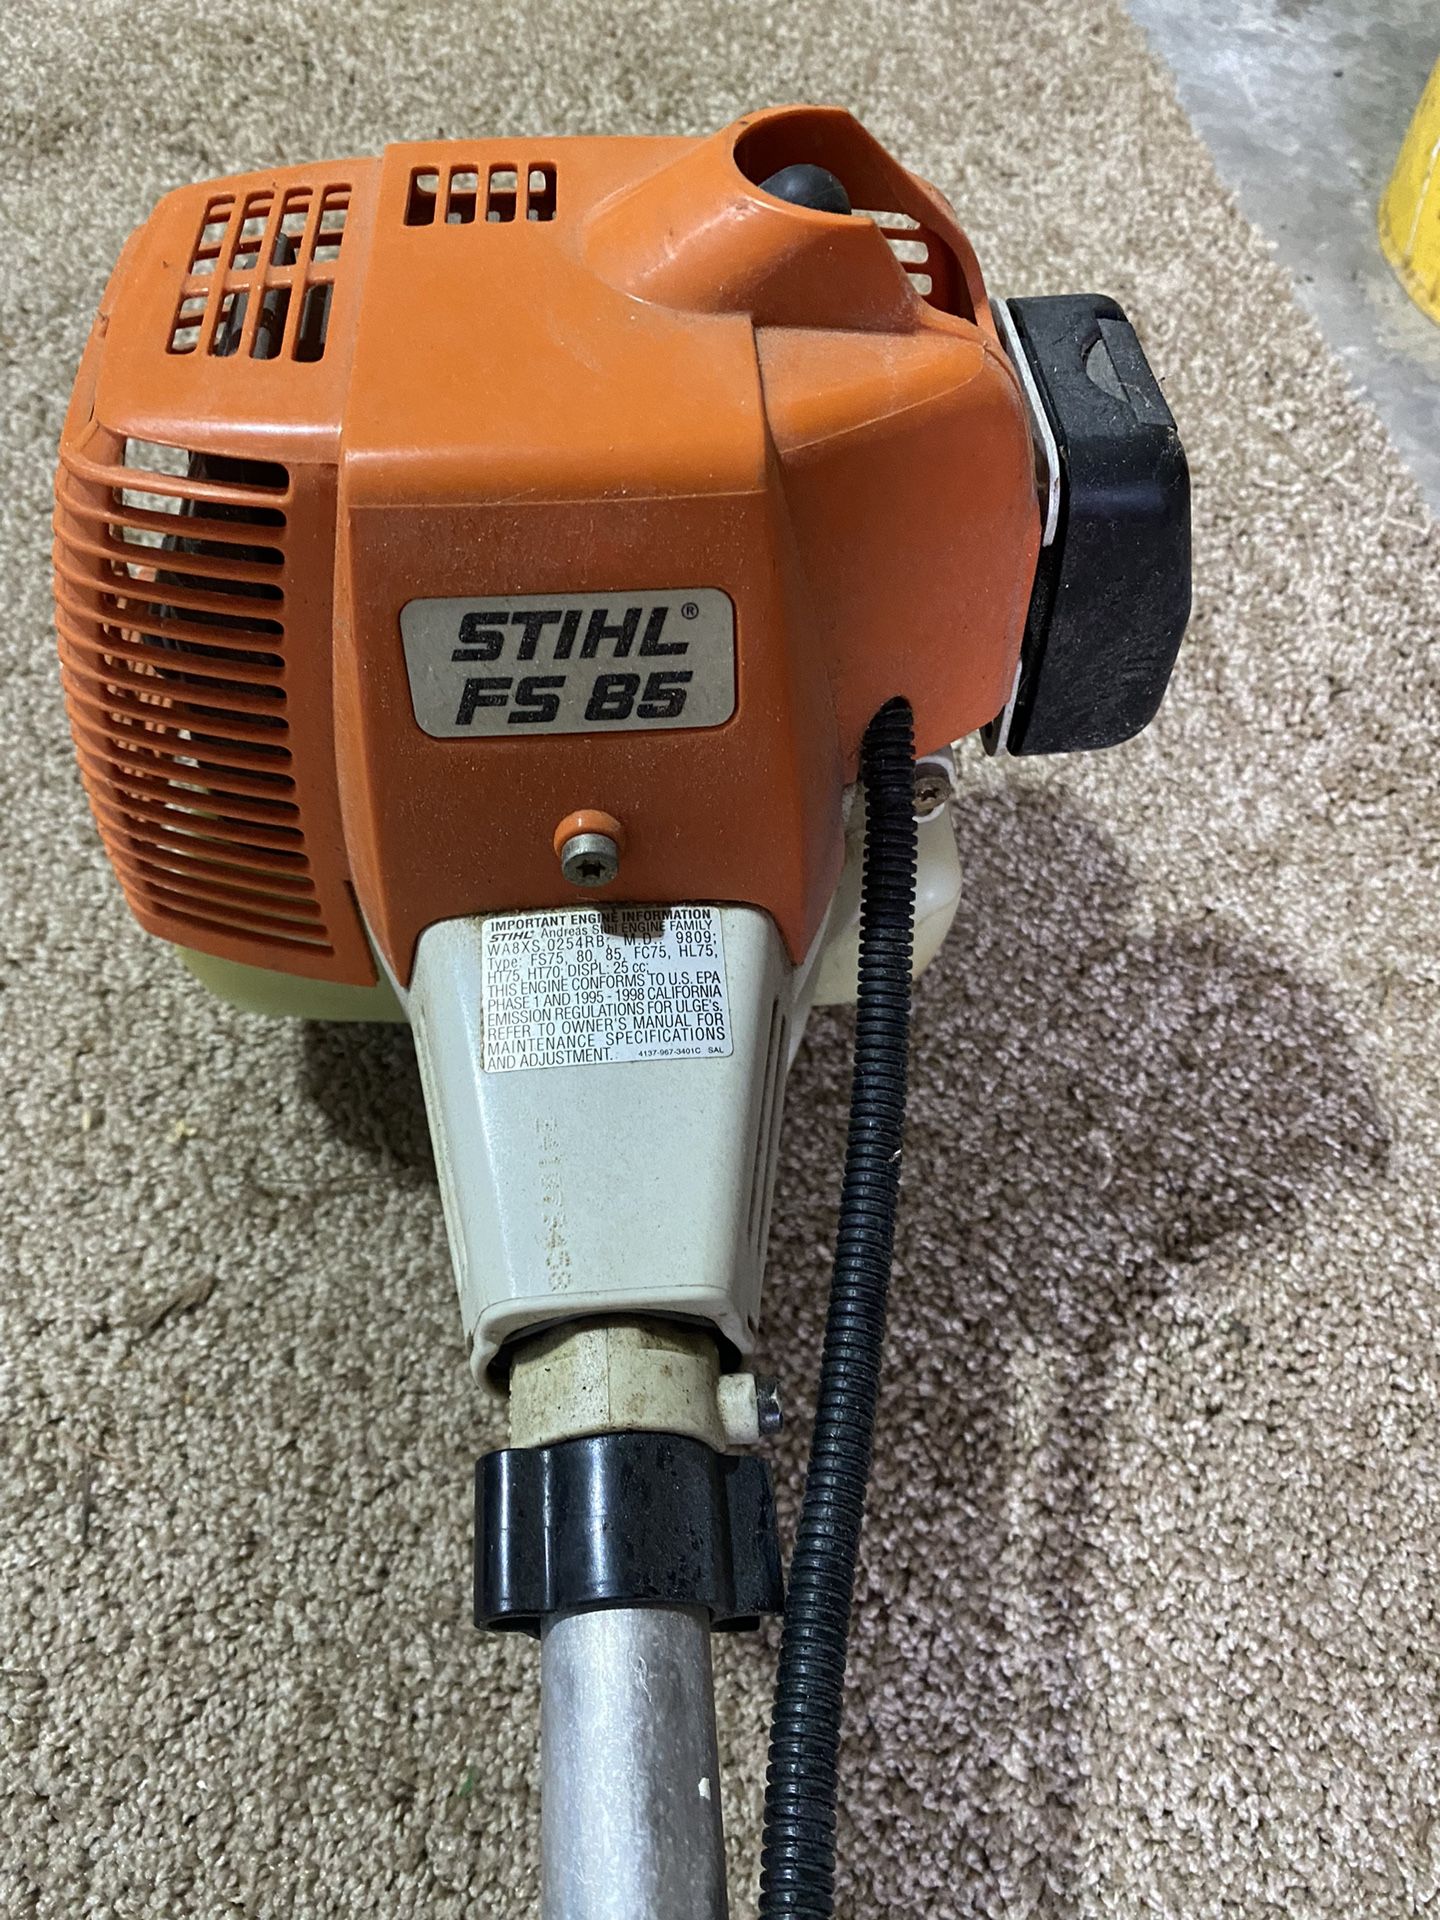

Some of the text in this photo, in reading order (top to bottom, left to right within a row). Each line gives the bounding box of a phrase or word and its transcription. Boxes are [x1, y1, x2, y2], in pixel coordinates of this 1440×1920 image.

[455, 670, 693, 725] FS 85
[491, 908, 711, 932] IMPORTANT ENGINE INFORMATION
[541, 927, 588, 938] Andreas
[622, 920, 665, 932] ENGINE
[670, 919, 712, 931] FAMILY
[675, 931, 717, 944] 9809;
[487, 944, 718, 972] Type: FS75, 80, 85, FC75, HL75,
[568, 962, 610, 978] DISPL:
[613, 960, 629, 974] 25
[487, 971, 721, 998] THIS ENGINE CONFORMS TO U.S. EPA
[487, 996, 530, 1012] PHASE
[543, 992, 571, 1007] AND
[574, 990, 604, 1004] 1995
[616, 988, 645, 1001] 1998
[647, 985, 722, 1000] CALIFORNIA
[487, 998, 723, 1027] EMISSION REGULATIONS FOR ULGE's.
[487, 1012, 724, 1041] REFER TO OWNER'S MANUAL FOR
[487, 1026, 726, 1056] MAINTENANCE SPECIFICATIONS
[638, 1046, 724, 1057] 4137-967-3401C SAL
[487, 1047, 613, 1071] AND ADJUSTMENT.
